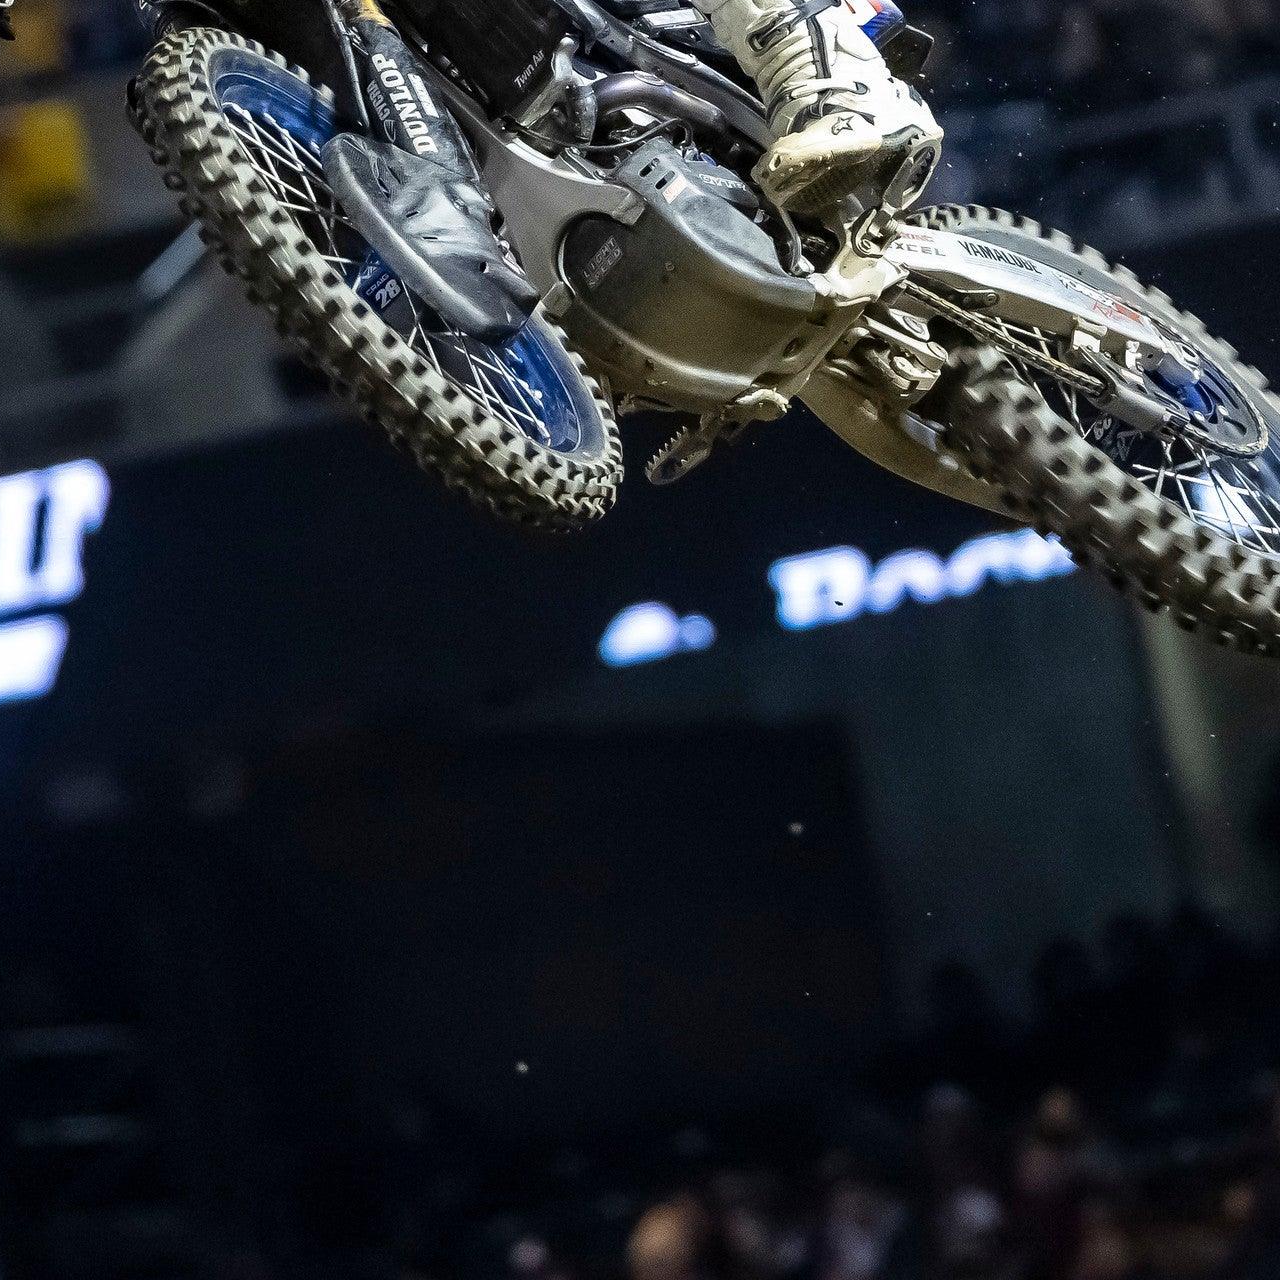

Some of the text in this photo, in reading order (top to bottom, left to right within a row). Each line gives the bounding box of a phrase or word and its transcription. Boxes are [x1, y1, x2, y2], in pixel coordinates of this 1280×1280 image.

[513, 49, 545, 90] Twin Air
[367, 80, 391, 125] CYCRA
[372, 53, 439, 155] DUNLOP
[364, 273, 390, 297] CRAIG
[374, 278, 402, 311] 28
